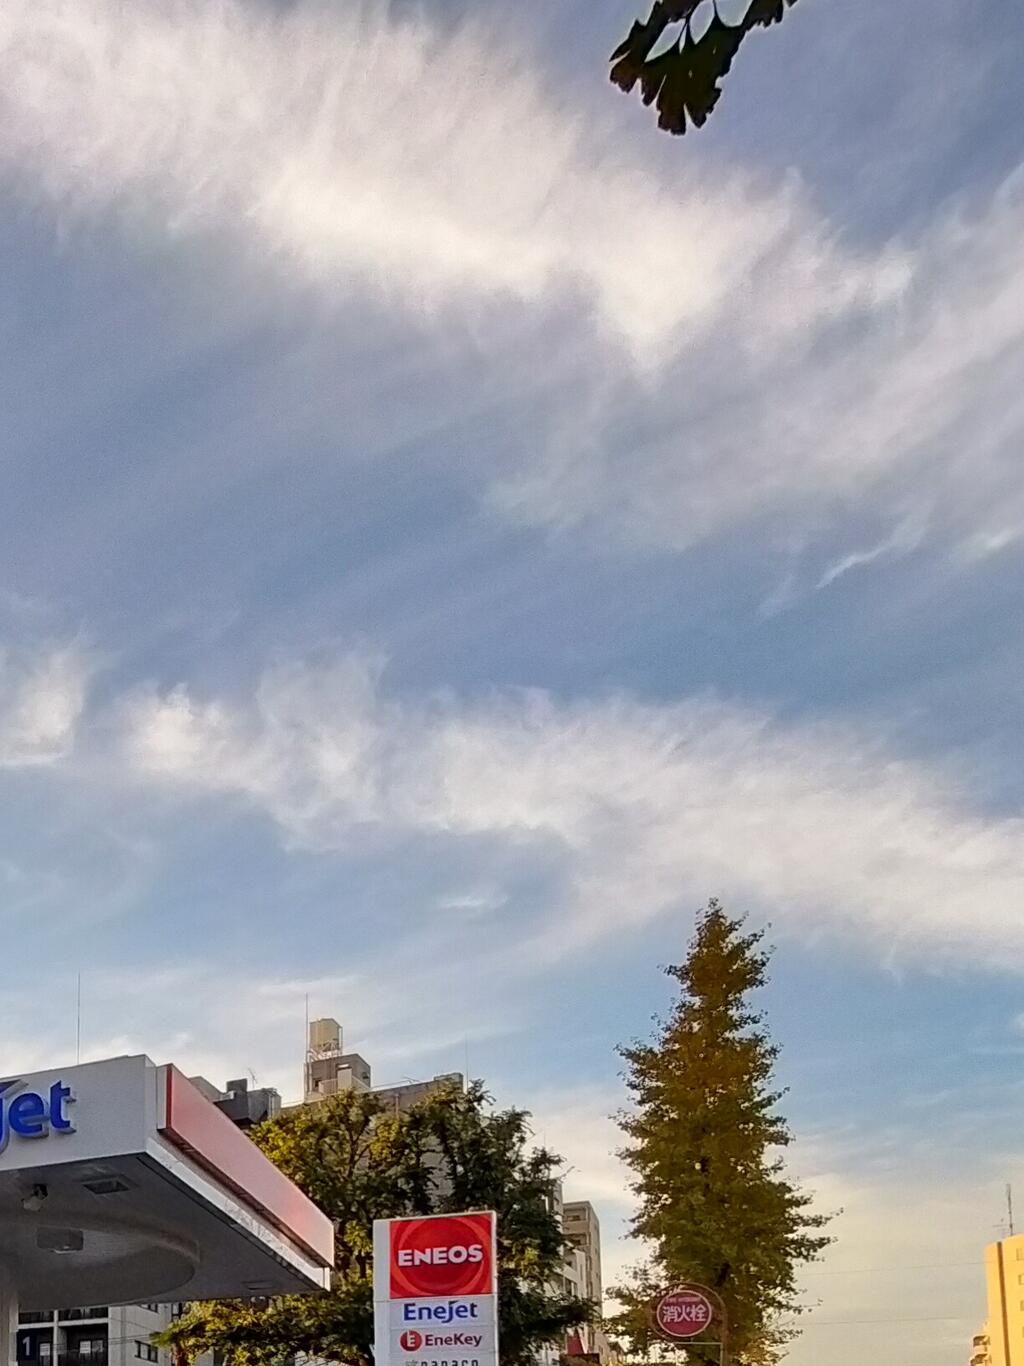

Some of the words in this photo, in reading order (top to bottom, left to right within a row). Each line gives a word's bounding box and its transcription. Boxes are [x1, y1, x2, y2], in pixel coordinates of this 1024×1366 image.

[398, 1244, 483, 1267] ENEOS
[403, 1301, 478, 1323] Enejet
[662, 1304, 707, 1323] 消火栓
[22, 1336, 31, 1356] 1
[425, 1333, 482, 1347] EneKey
